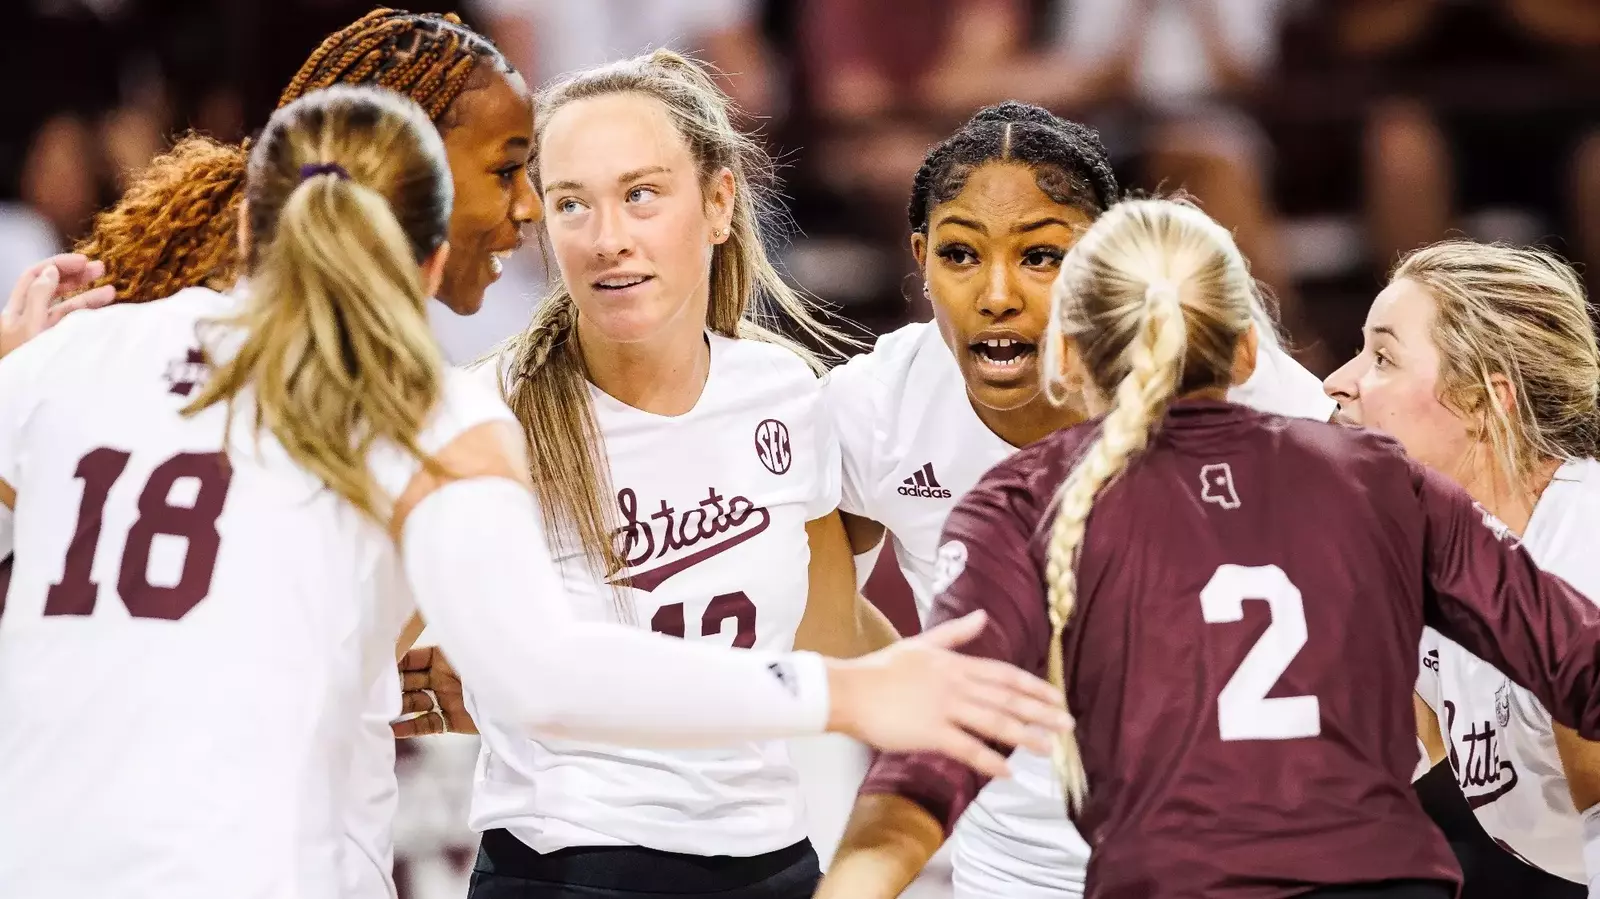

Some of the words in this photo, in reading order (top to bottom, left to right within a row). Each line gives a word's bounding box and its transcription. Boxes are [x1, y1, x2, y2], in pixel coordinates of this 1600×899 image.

[755, 419, 791, 475] SEC
[897, 484, 952, 498] adidas
[43, 447, 233, 620] 18
[604, 487, 756, 579] State
[1199, 563, 1322, 742] 2
